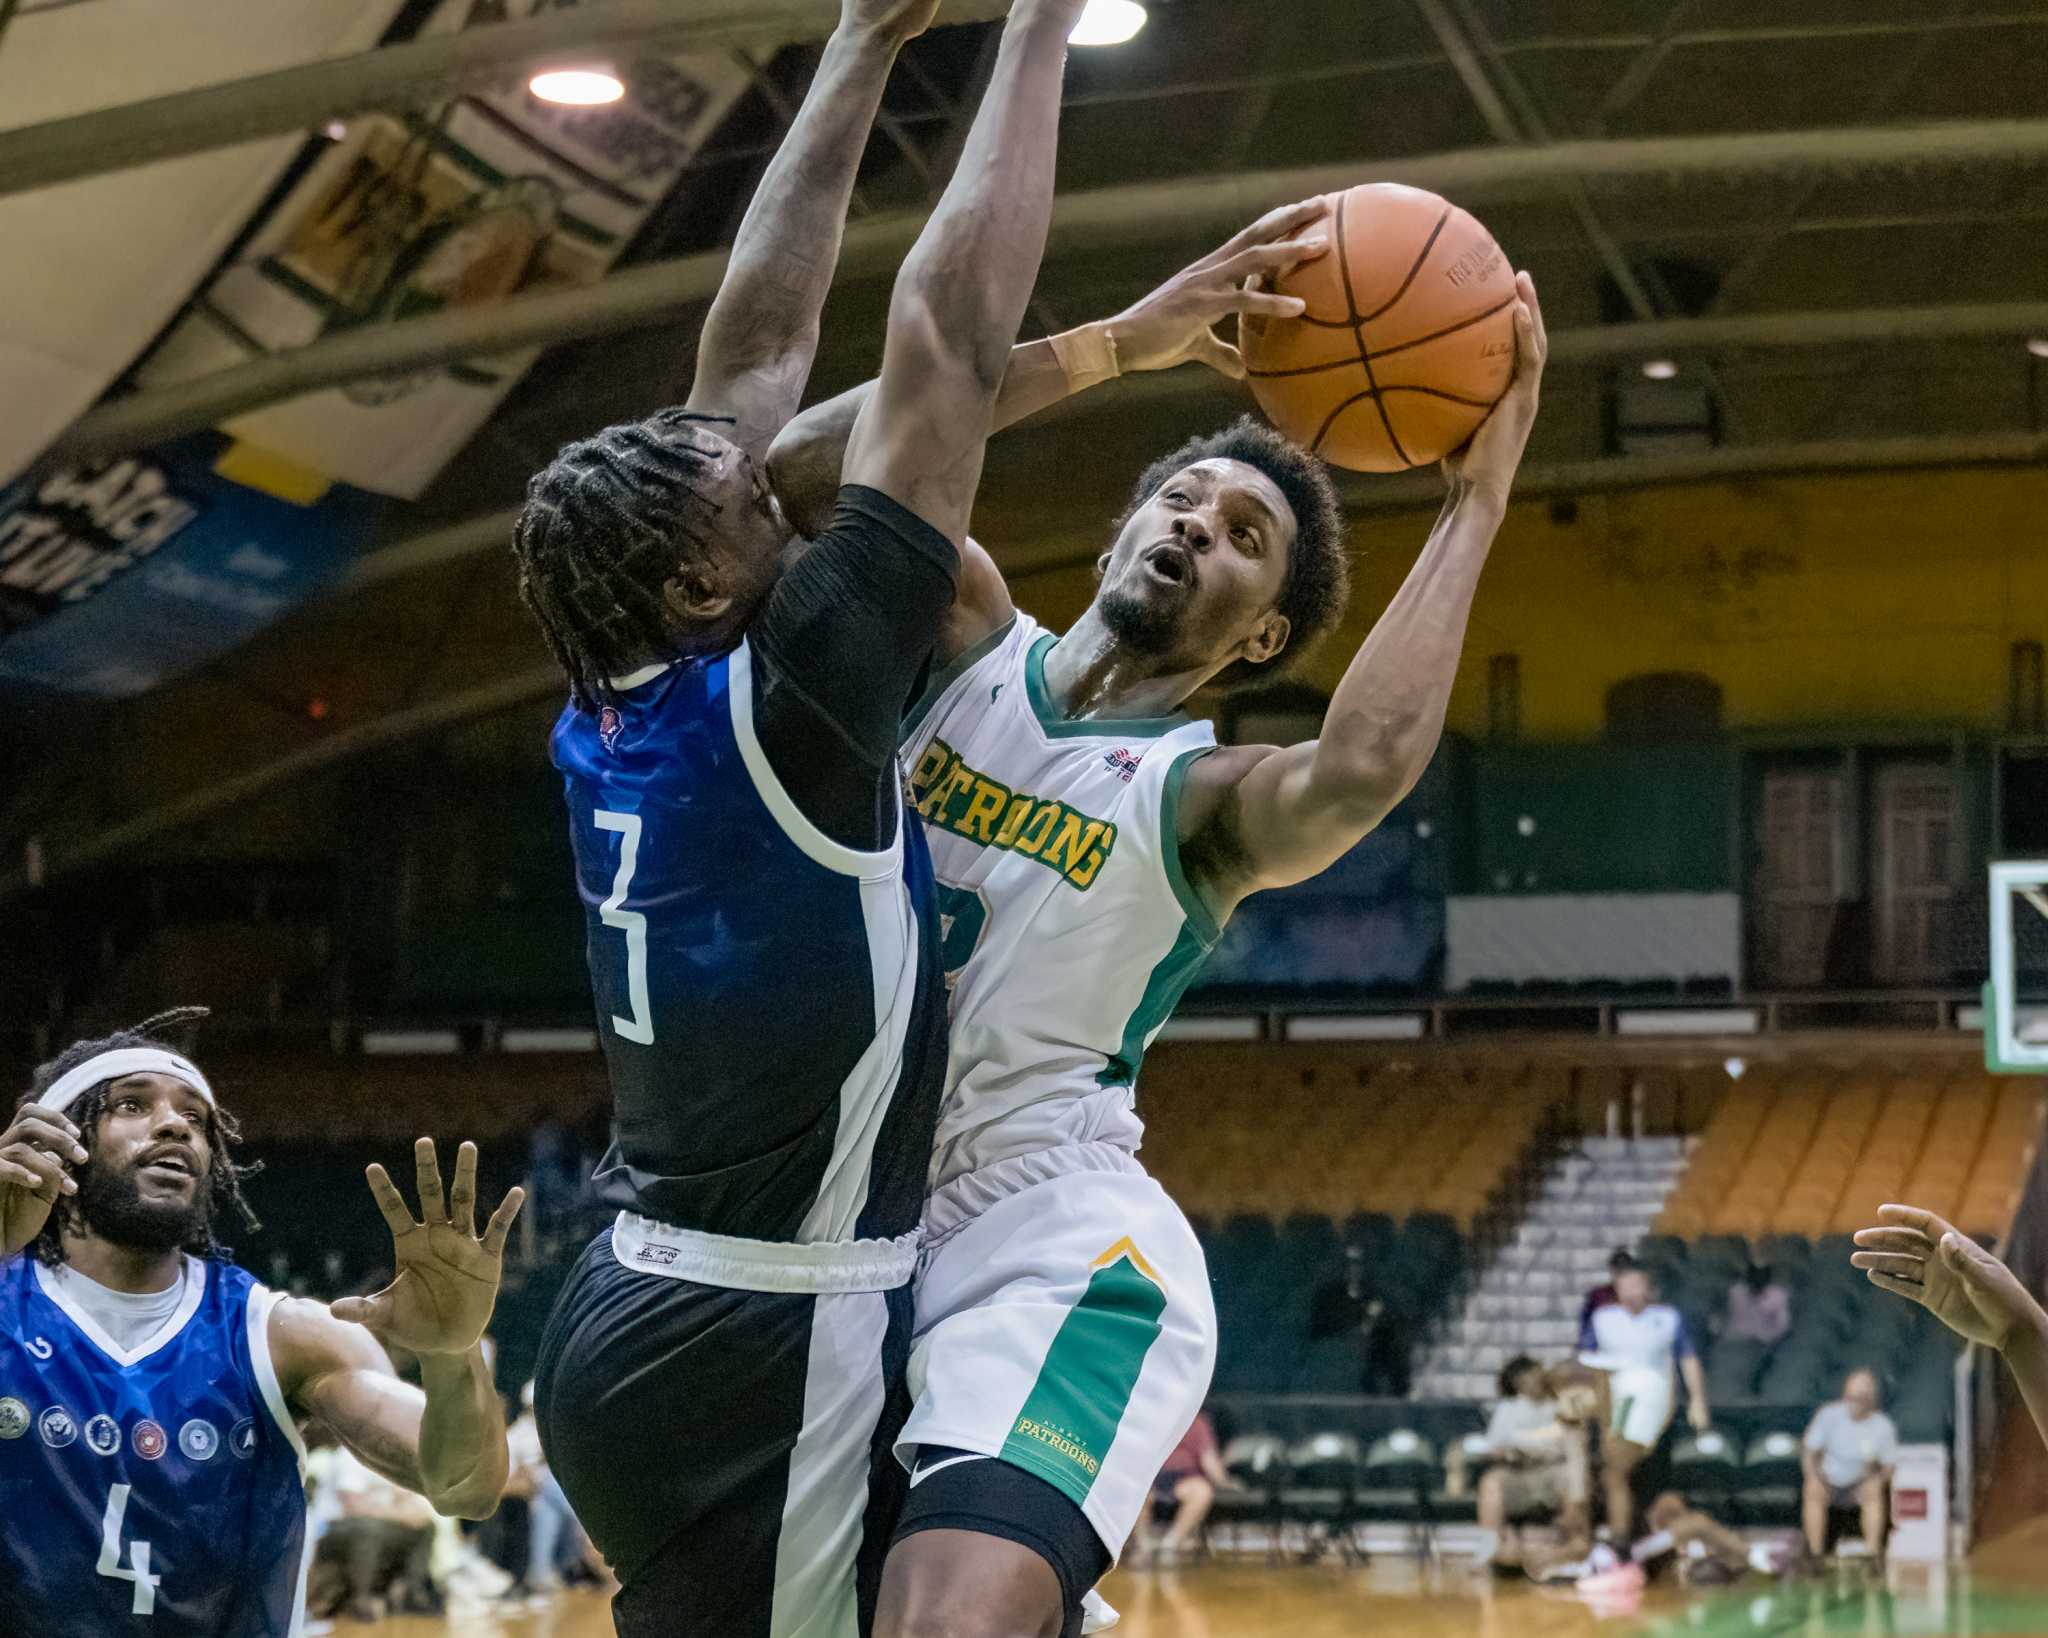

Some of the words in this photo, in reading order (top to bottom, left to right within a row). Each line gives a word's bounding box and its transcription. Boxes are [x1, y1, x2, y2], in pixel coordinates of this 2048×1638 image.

[594, 809, 655, 1045] 3
[1017, 1418, 1098, 1475] PATROONS
[96, 1482, 161, 1615] 4
